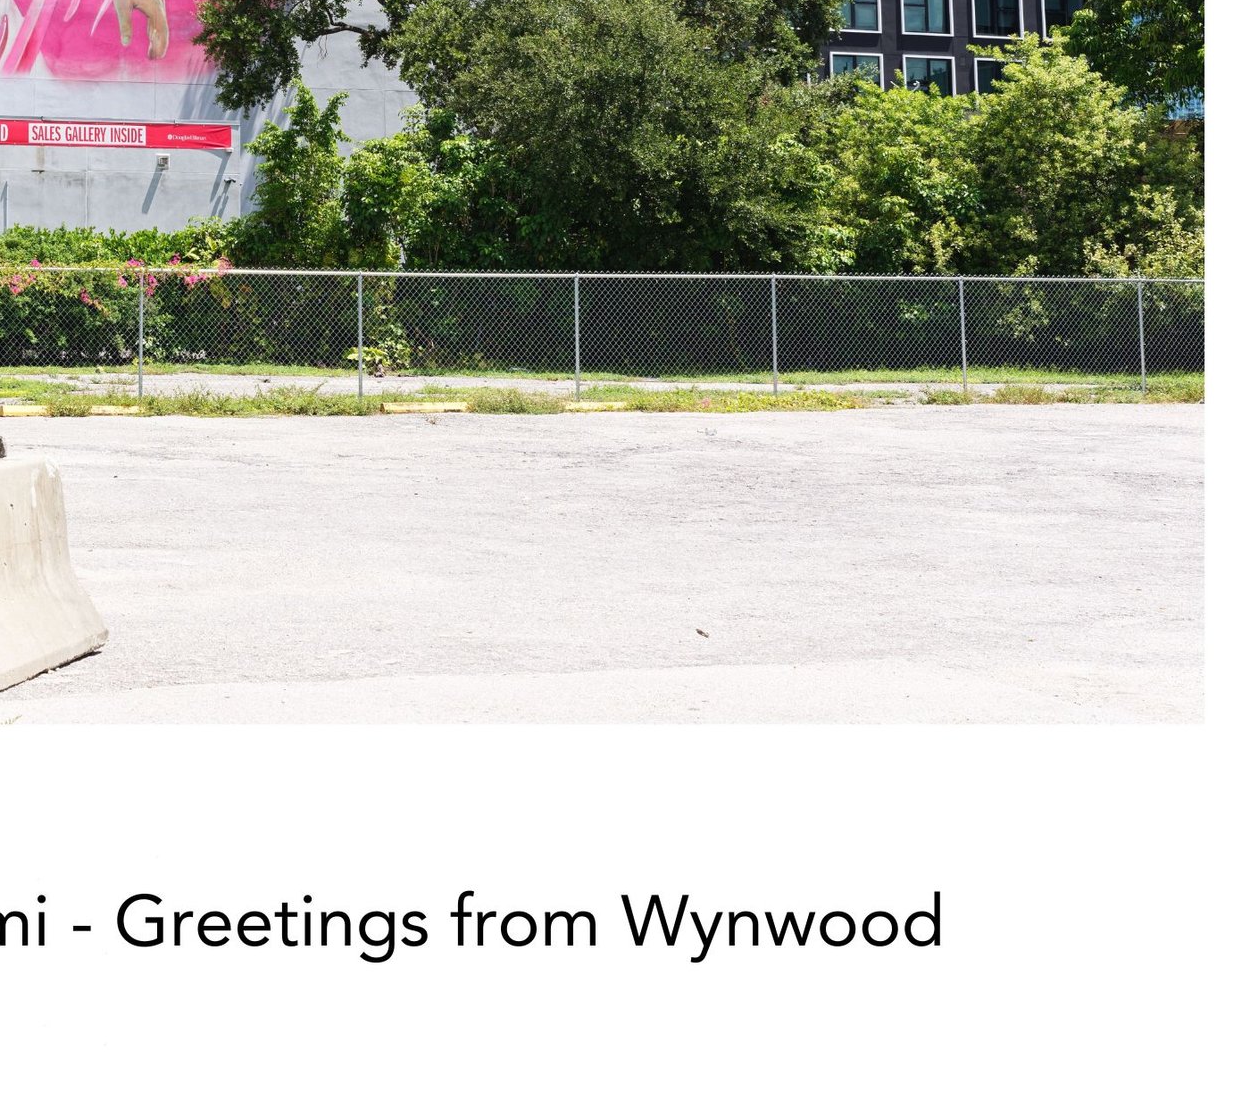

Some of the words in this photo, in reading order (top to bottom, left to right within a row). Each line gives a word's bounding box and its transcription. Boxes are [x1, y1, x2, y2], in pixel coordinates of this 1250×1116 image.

[32, 125, 61, 142] SALES
[65, 126, 107, 143] GALLERY
[110, 127, 143, 144] INSIDE
